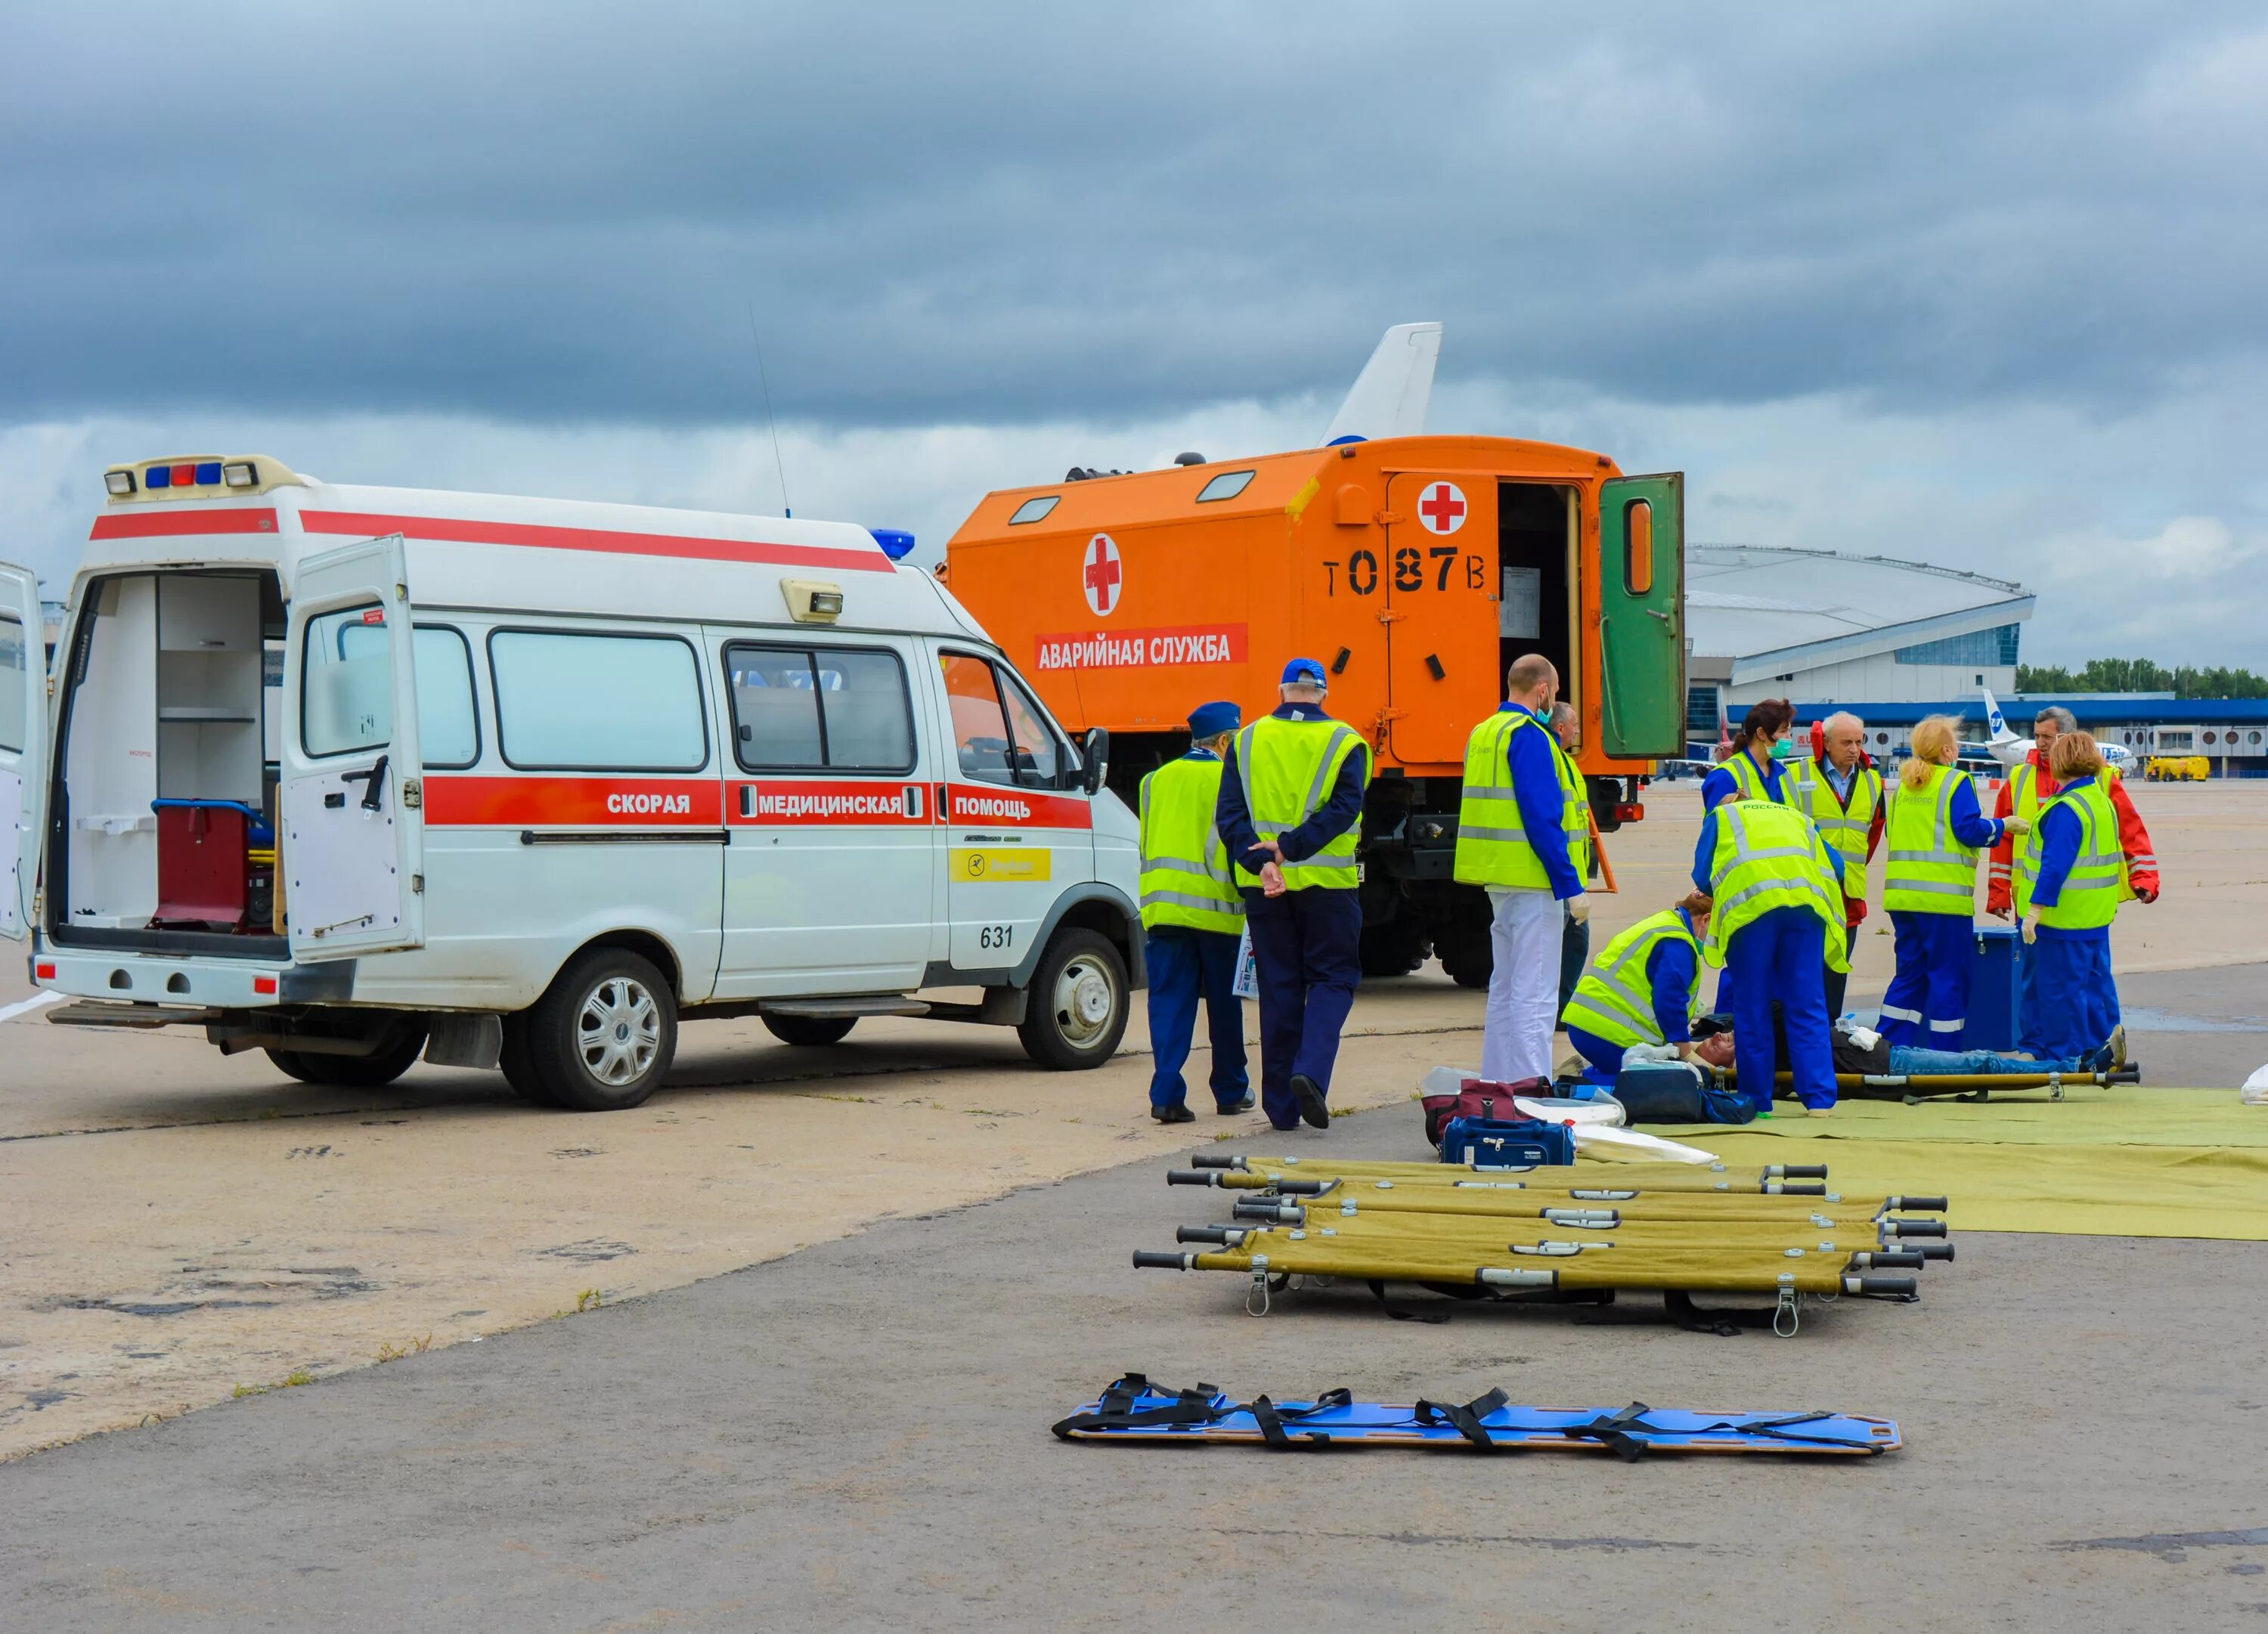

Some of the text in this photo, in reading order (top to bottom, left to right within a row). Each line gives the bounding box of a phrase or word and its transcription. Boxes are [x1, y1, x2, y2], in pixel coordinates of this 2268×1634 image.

[1039, 633, 1231, 669] АВАРИЙНАЯ СЛУЖБА
[607, 794, 1031, 820] СКОРАЯ МЕДИЦИНСКАЯ ПОМОЩЬ
[981, 924, 1012, 949] 631
